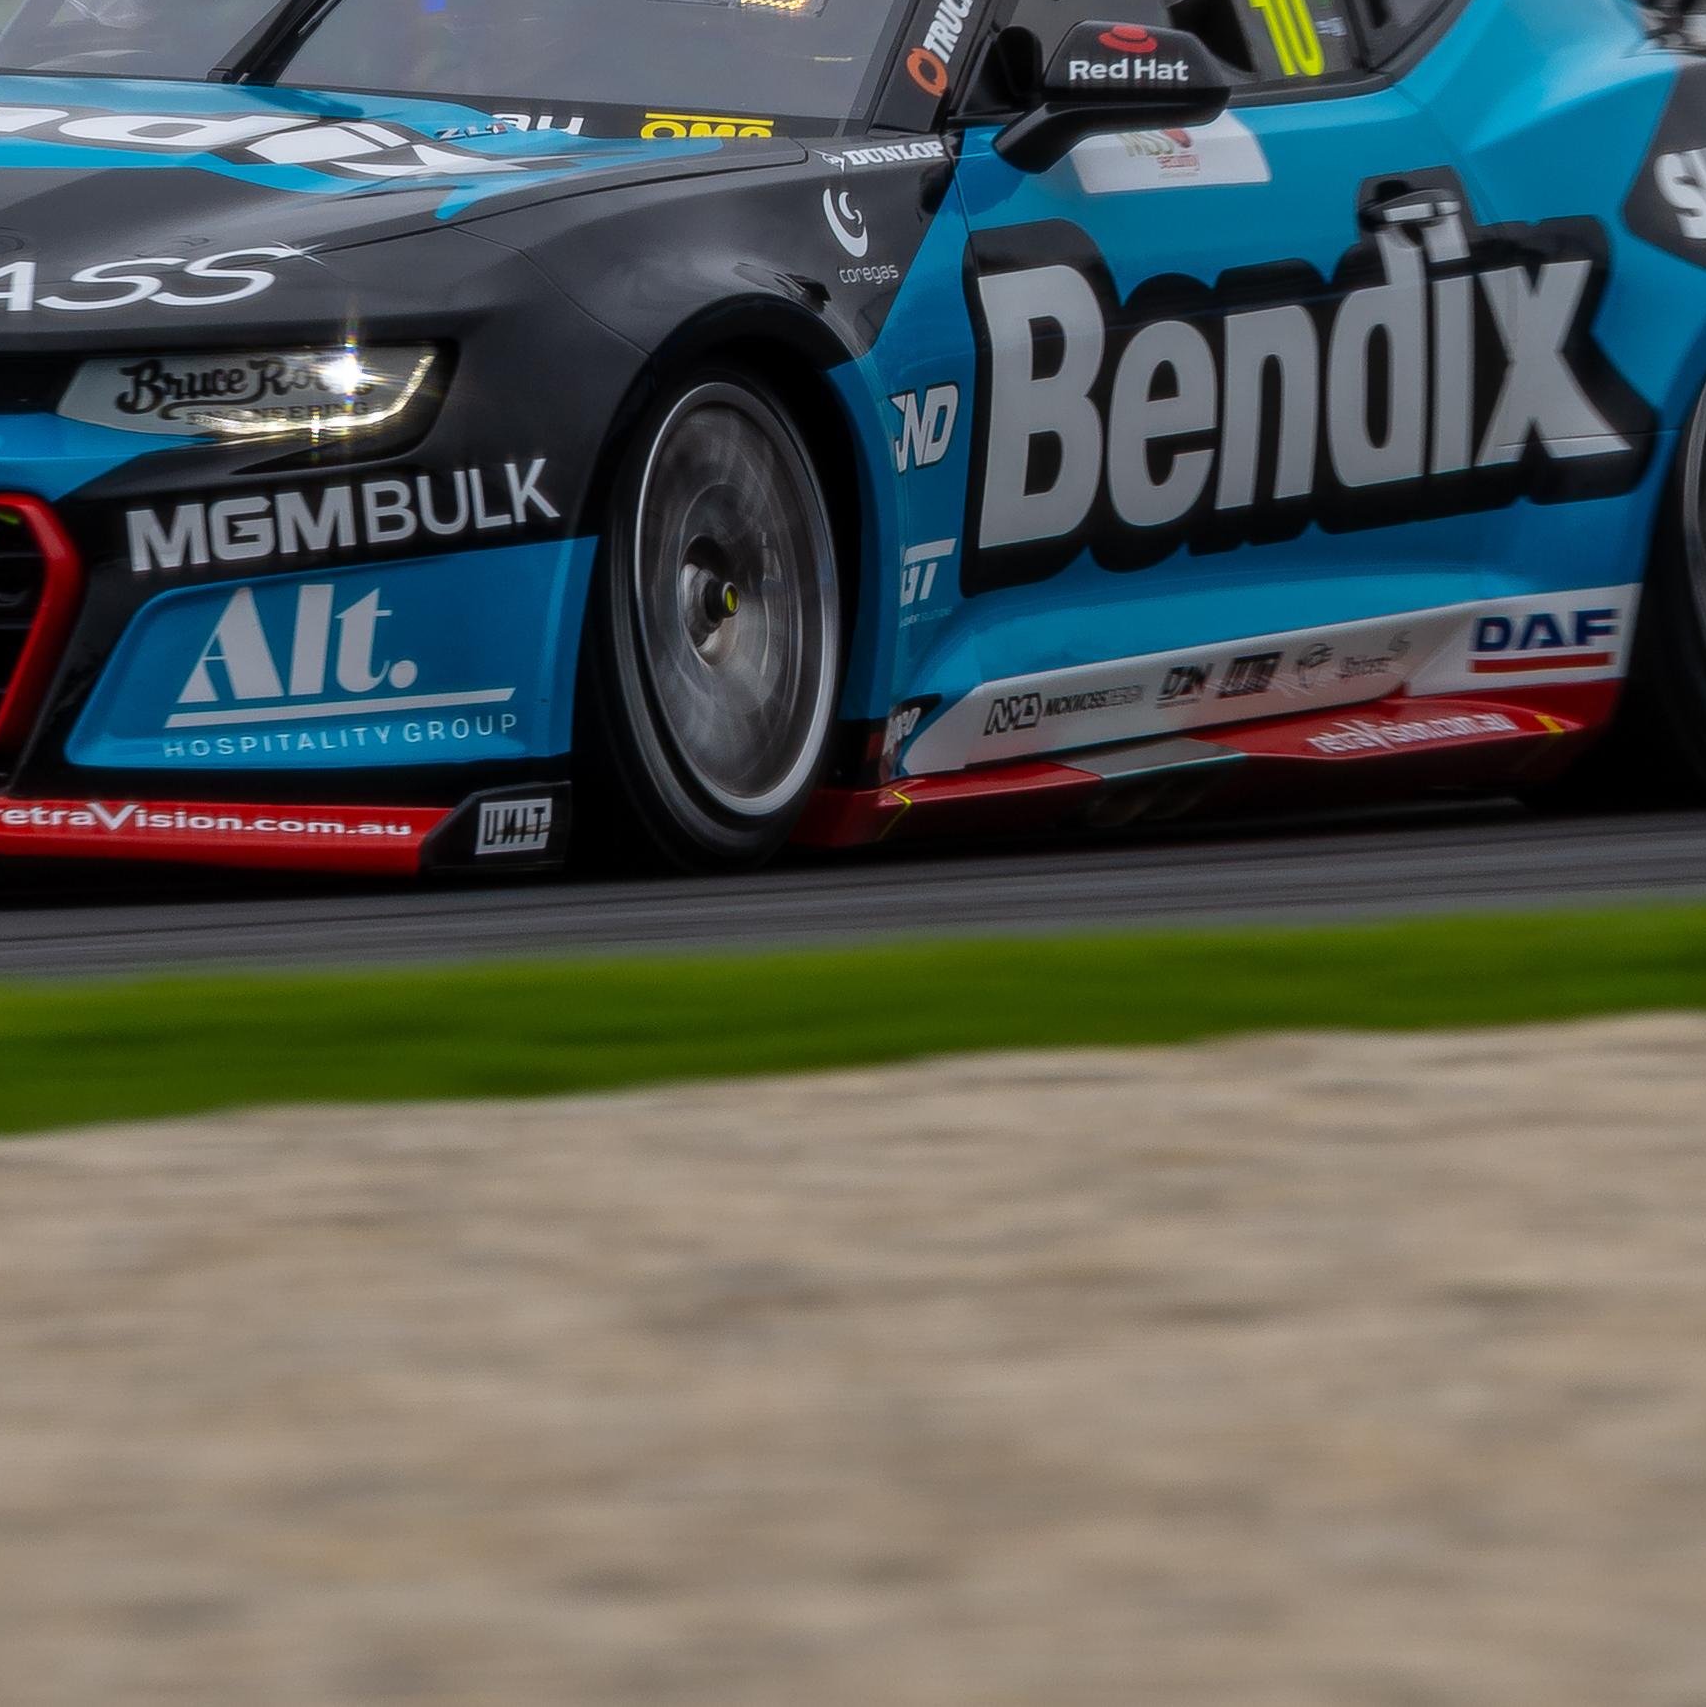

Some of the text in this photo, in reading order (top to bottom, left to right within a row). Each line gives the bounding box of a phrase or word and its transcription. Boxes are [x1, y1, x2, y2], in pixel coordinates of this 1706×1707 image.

[1069, 57, 1190, 82] Red Hat
[842, 141, 945, 166] DUNLOP
[839, 263, 900, 285] coregas
[115, 358, 246, 415] Bruce
[977, 200, 1633, 550] Bendix
[127, 458, 561, 573] MGMBULK
[177, 583, 419, 705] Alt.
[1471, 608, 1617, 653] DAF
[164, 712, 519, 760] HOSPITALITY GROUP
